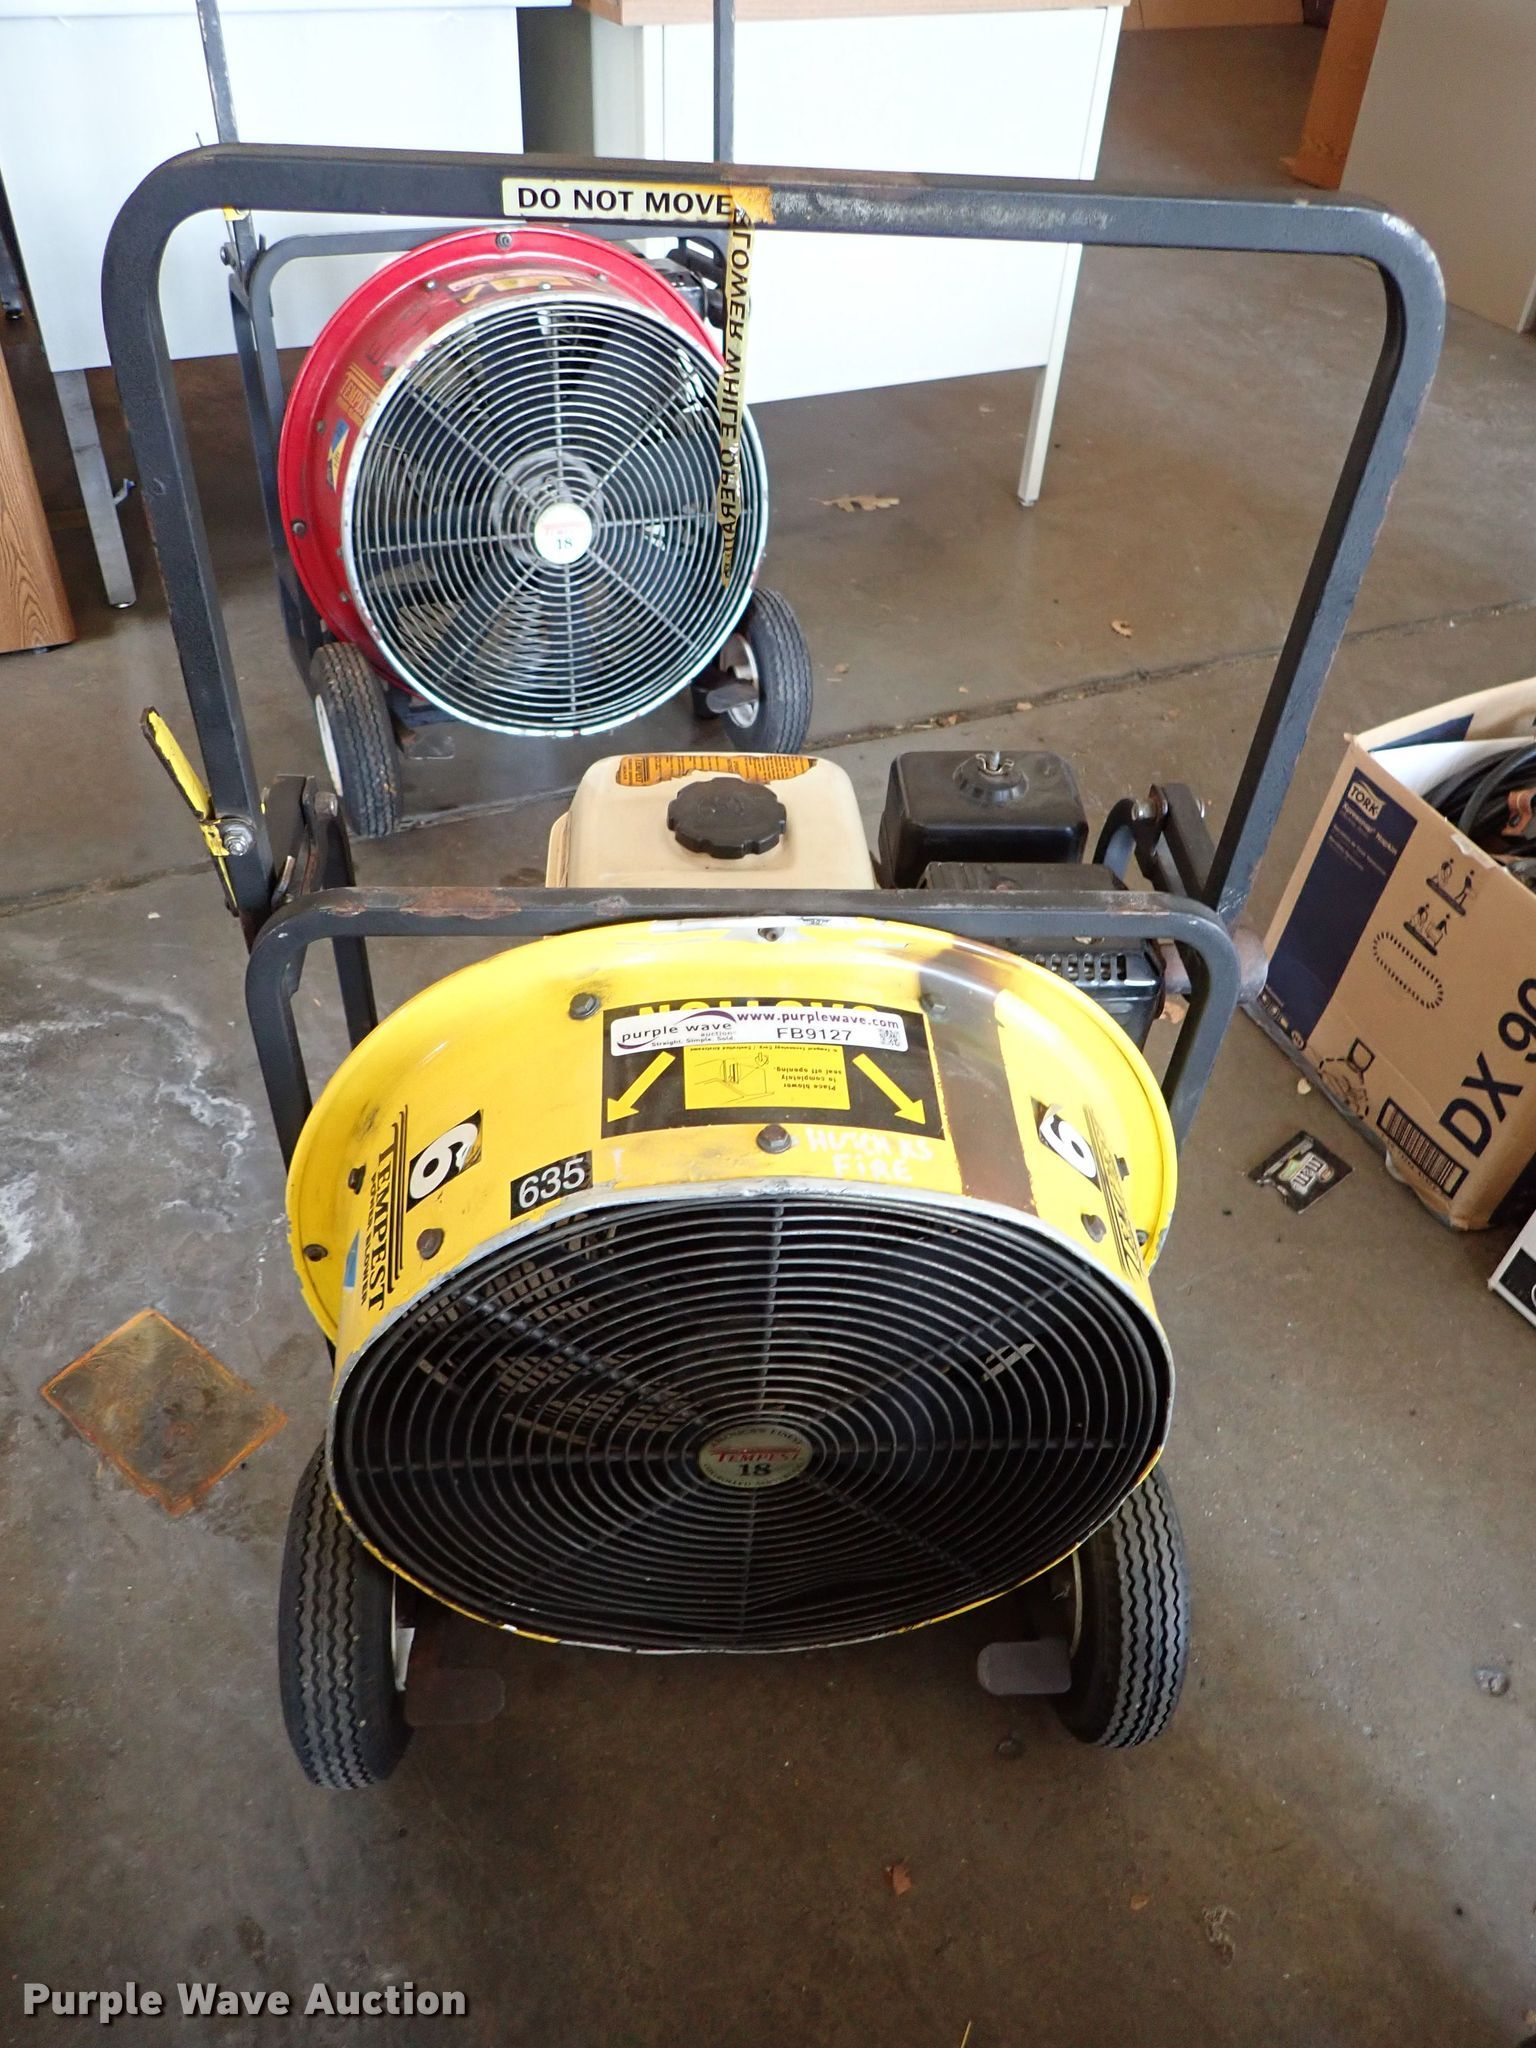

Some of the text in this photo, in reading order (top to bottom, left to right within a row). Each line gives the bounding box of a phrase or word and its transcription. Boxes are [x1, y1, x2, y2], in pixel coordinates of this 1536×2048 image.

[517, 187, 734, 216] DO NOT MOVE
[1350, 786, 1379, 817] TORK
[622, 1022, 733, 1043] purple wave
[737, 1011, 900, 1030] www.purplewave.com
[776, 1027, 853, 1042] FB9127
[1439, 1051, 1524, 1158] DX
[519, 1157, 586, 1209] 635
[368, 1140, 398, 1311] TEMPEST
[739, 1463, 771, 1476] 18
